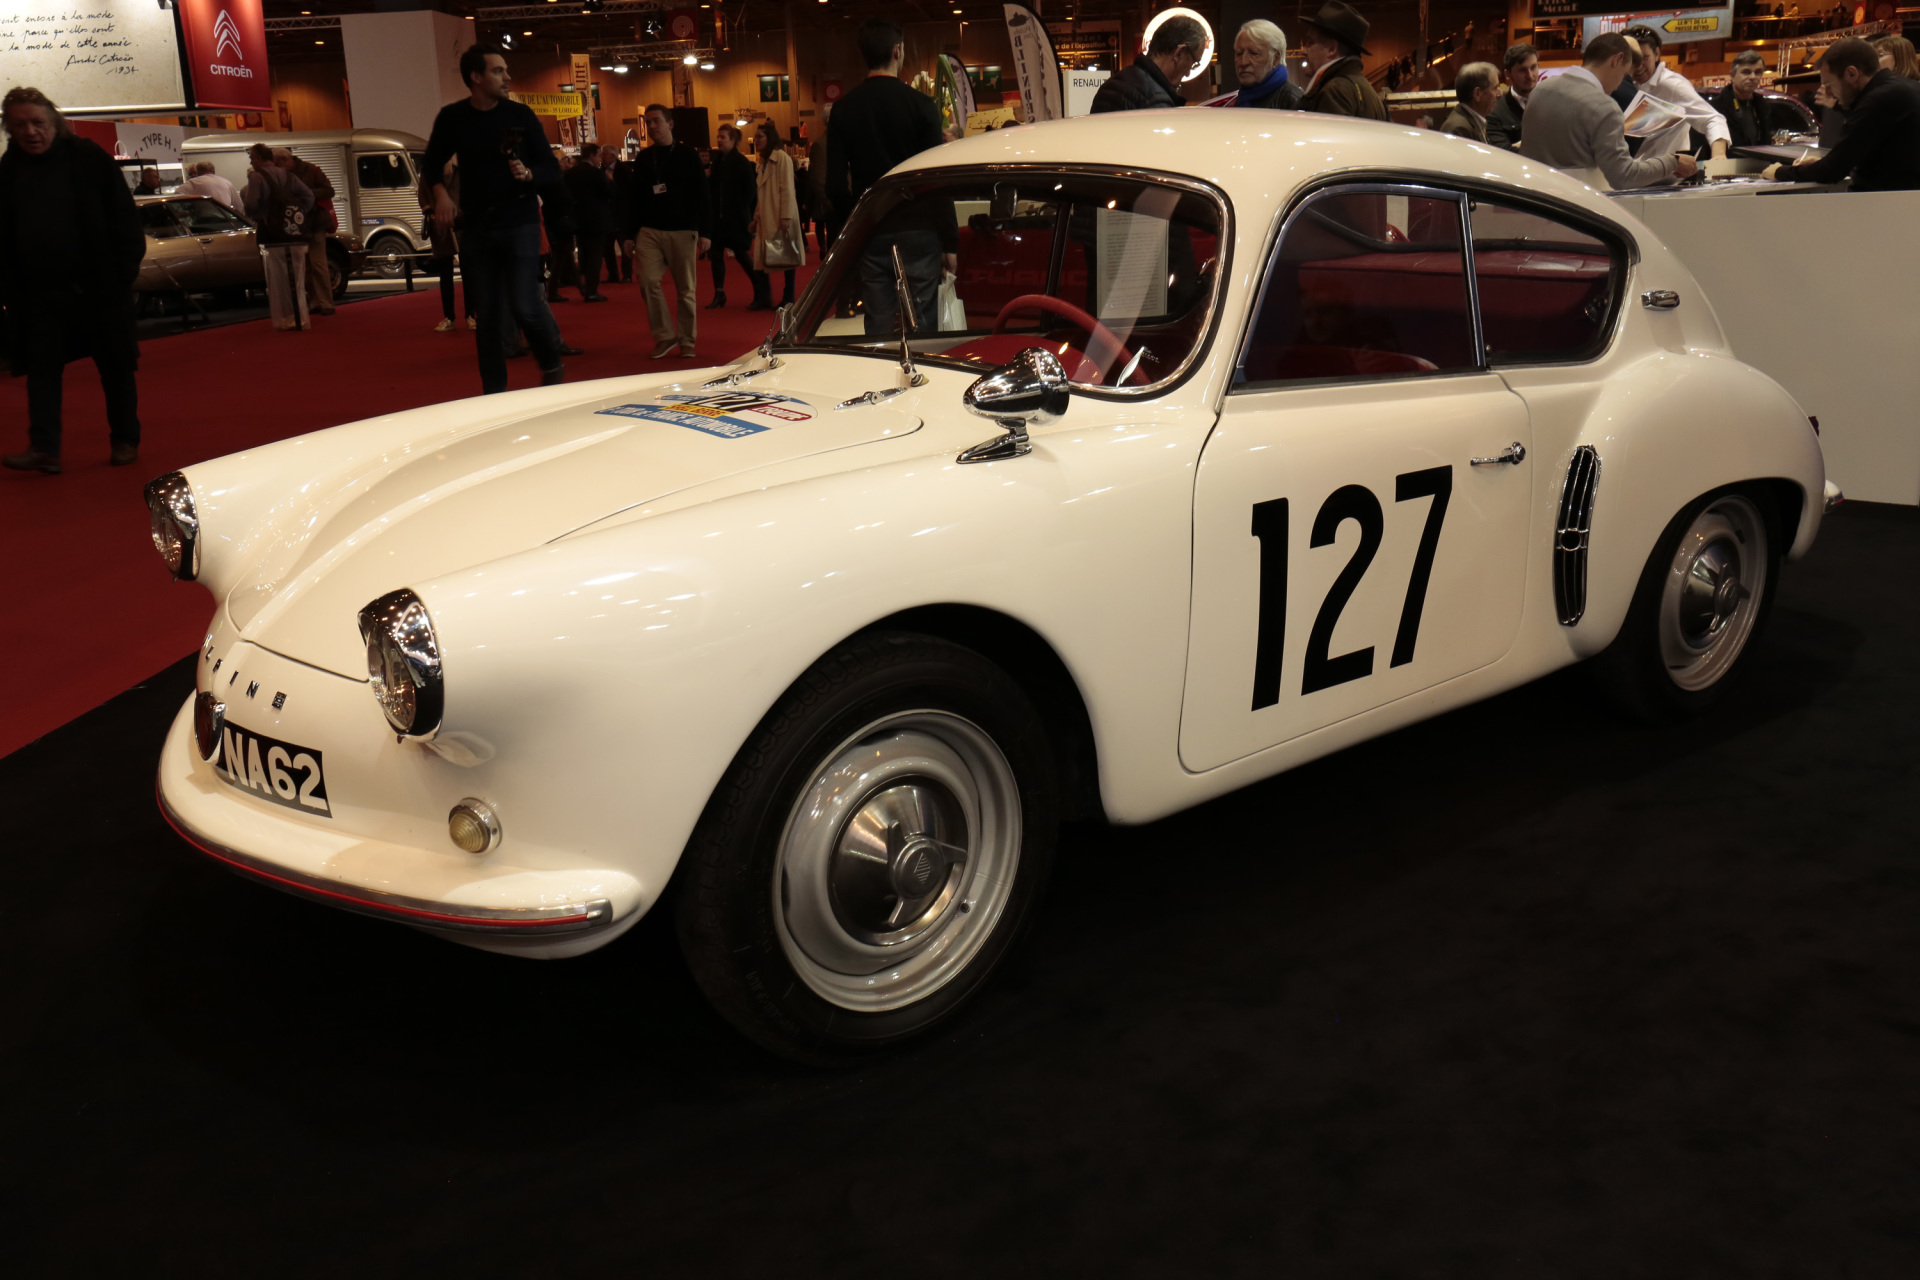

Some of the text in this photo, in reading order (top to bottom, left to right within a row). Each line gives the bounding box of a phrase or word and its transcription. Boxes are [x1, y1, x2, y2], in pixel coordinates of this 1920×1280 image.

[71, 10, 83, 20] la
[87, 10, 114, 20] mode
[26, 41, 53, 50] mode
[60, 40, 70, 49] de
[142, 132, 171, 148] TYPE H
[1251, 464, 1453, 712] 127
[223, 726, 329, 811] NA62
